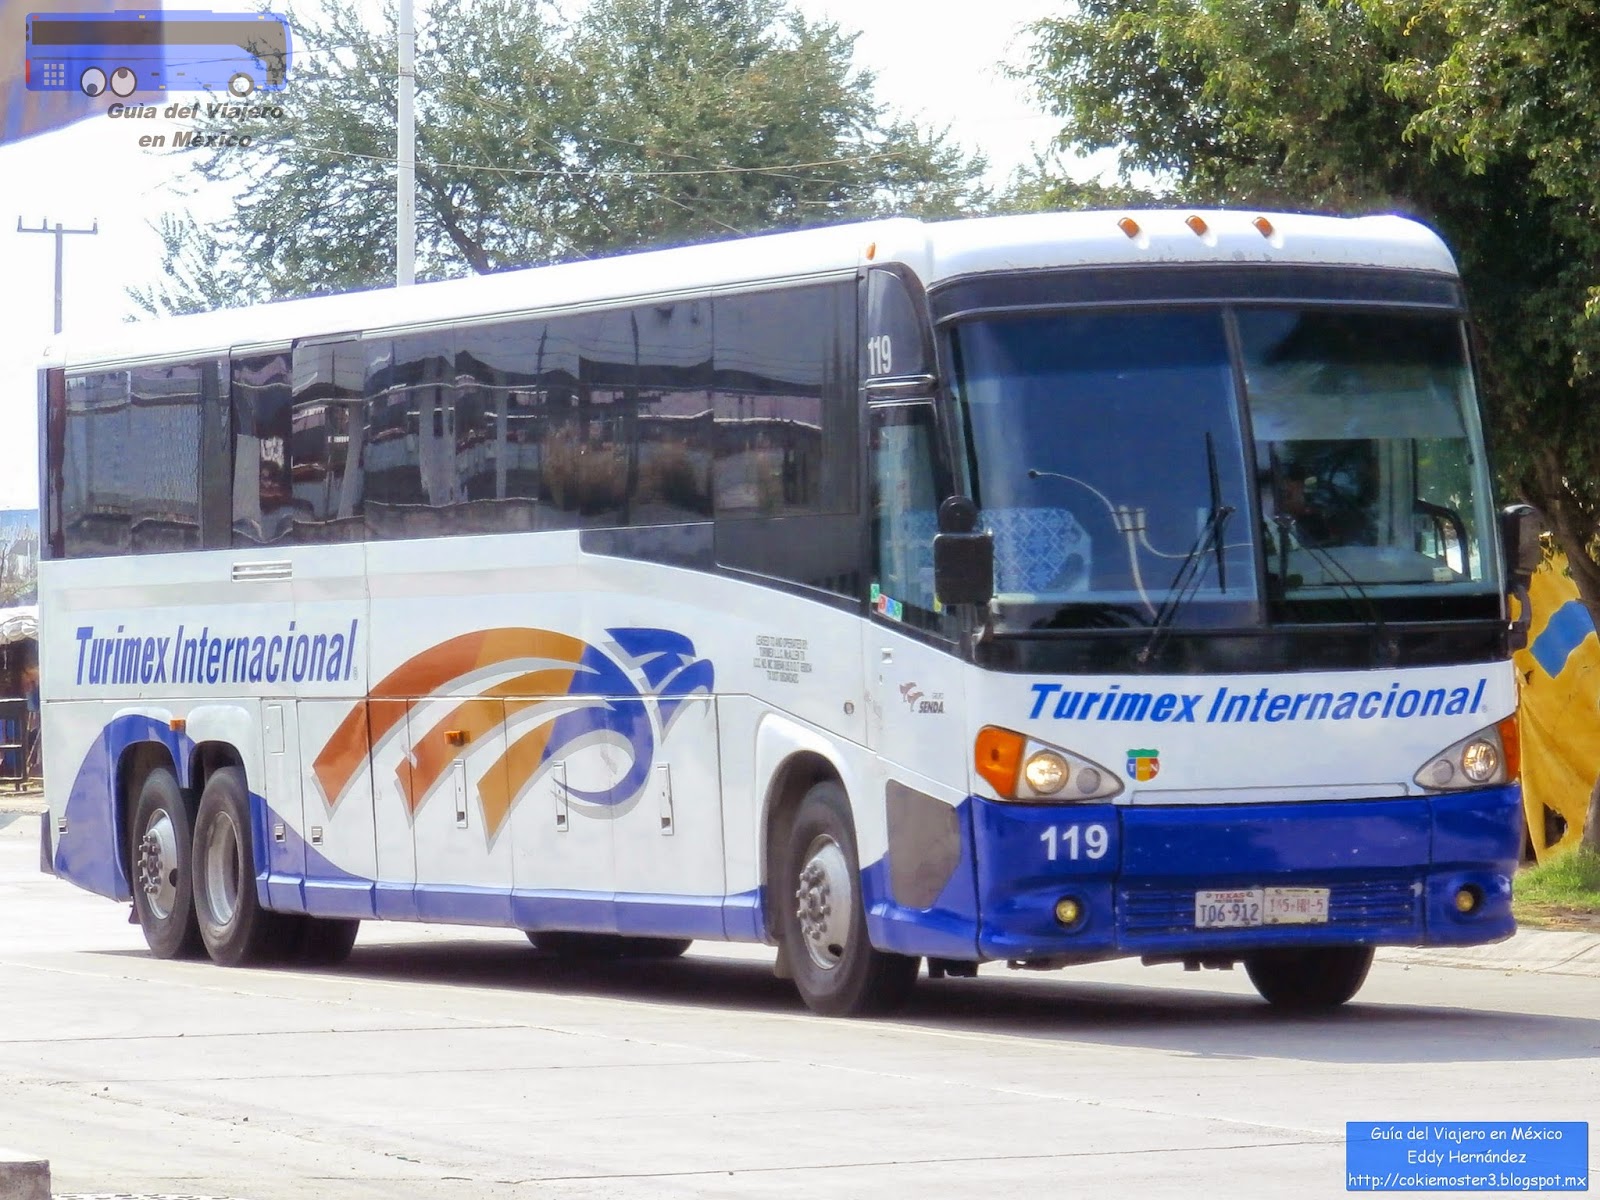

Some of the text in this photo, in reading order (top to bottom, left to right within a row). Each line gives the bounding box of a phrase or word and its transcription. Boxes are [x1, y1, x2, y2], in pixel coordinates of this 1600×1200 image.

[867, 334, 892, 376] 119
[76, 618, 358, 685] Turimex Internacional
[918, 701, 944, 713] SENDA
[1029, 678, 1487, 723] Turimex Internacional
[1039, 824, 1109, 862] 119
